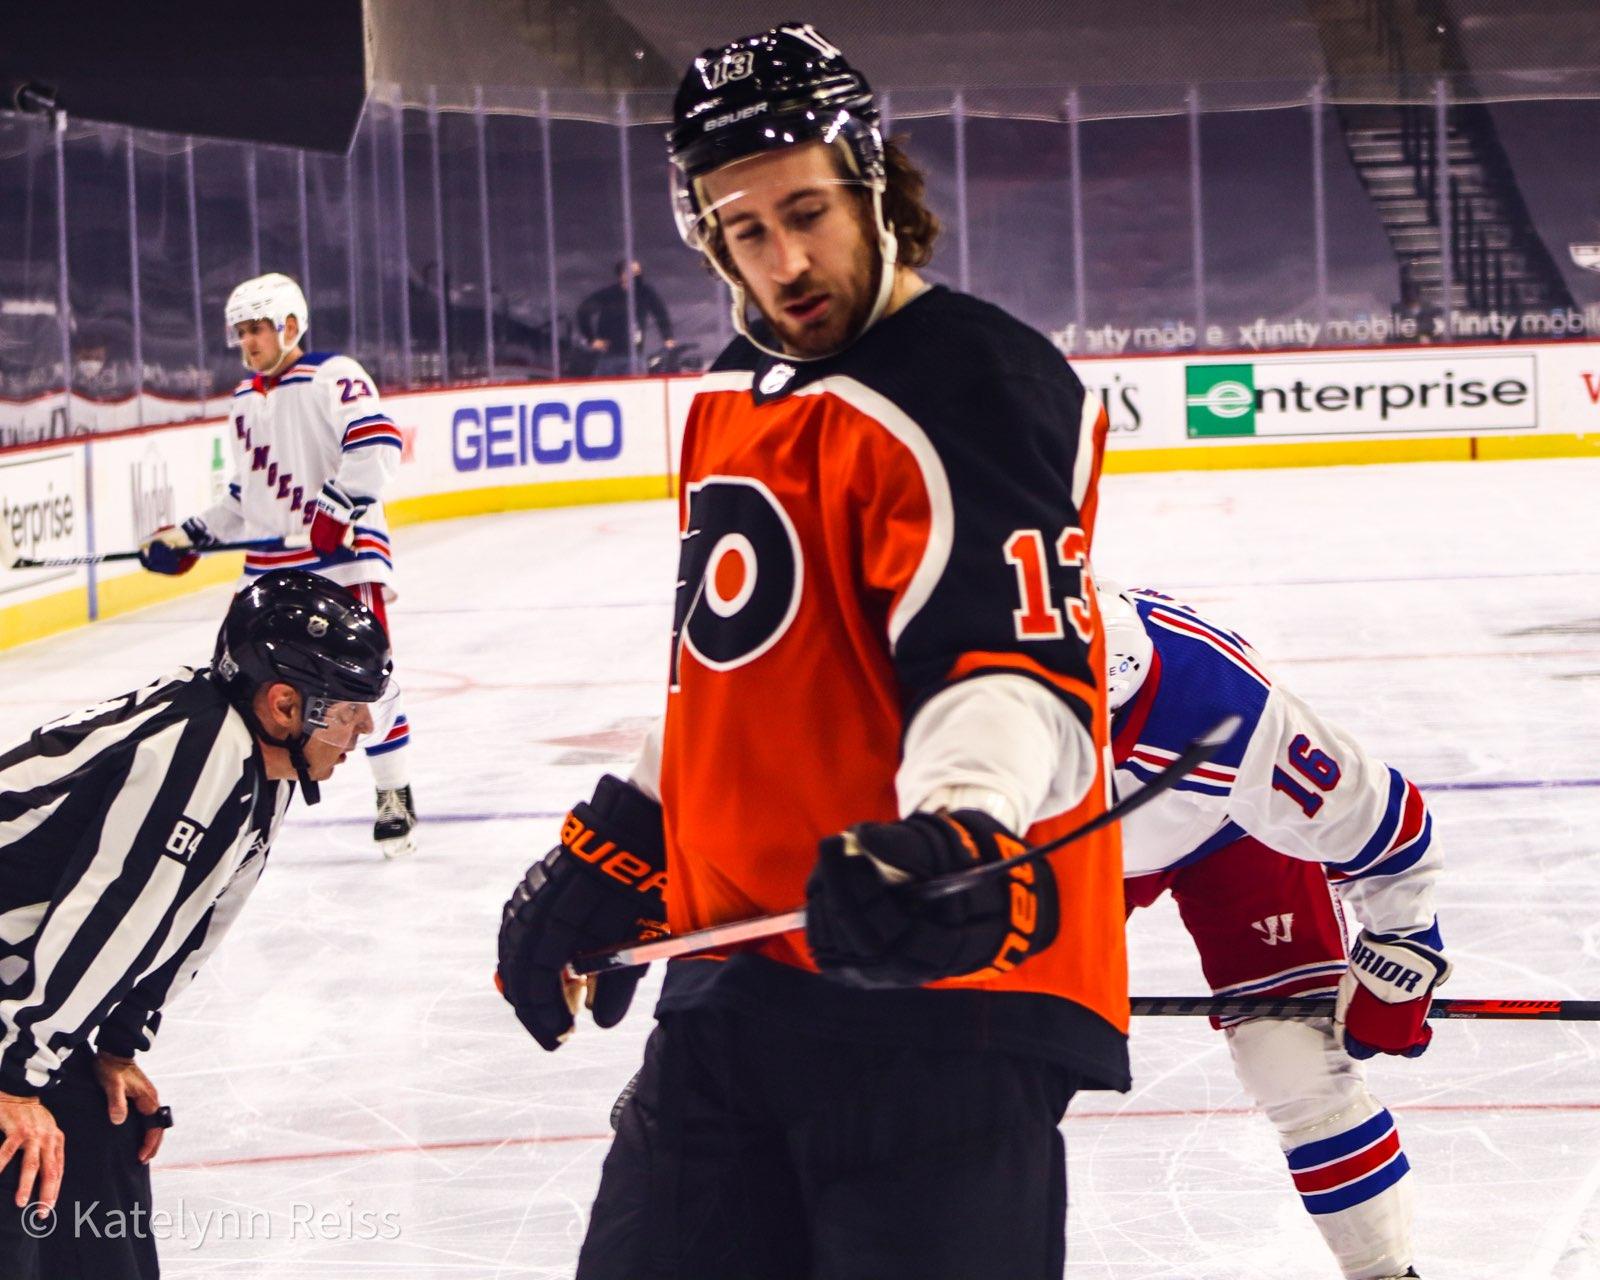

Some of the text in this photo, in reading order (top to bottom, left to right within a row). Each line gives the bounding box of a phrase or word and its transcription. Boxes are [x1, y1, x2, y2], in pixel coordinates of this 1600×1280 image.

[703, 102, 769, 132] BAUER
[1134, 320, 1223, 348] mobe
[1521, 303, 1600, 337] mobil
[1204, 372, 1529, 421] enterprise
[453, 399, 623, 472] GEICO
[1003, 526, 1094, 644] 13
[1271, 733, 1341, 819] 16
[165, 820, 204, 862] 84
